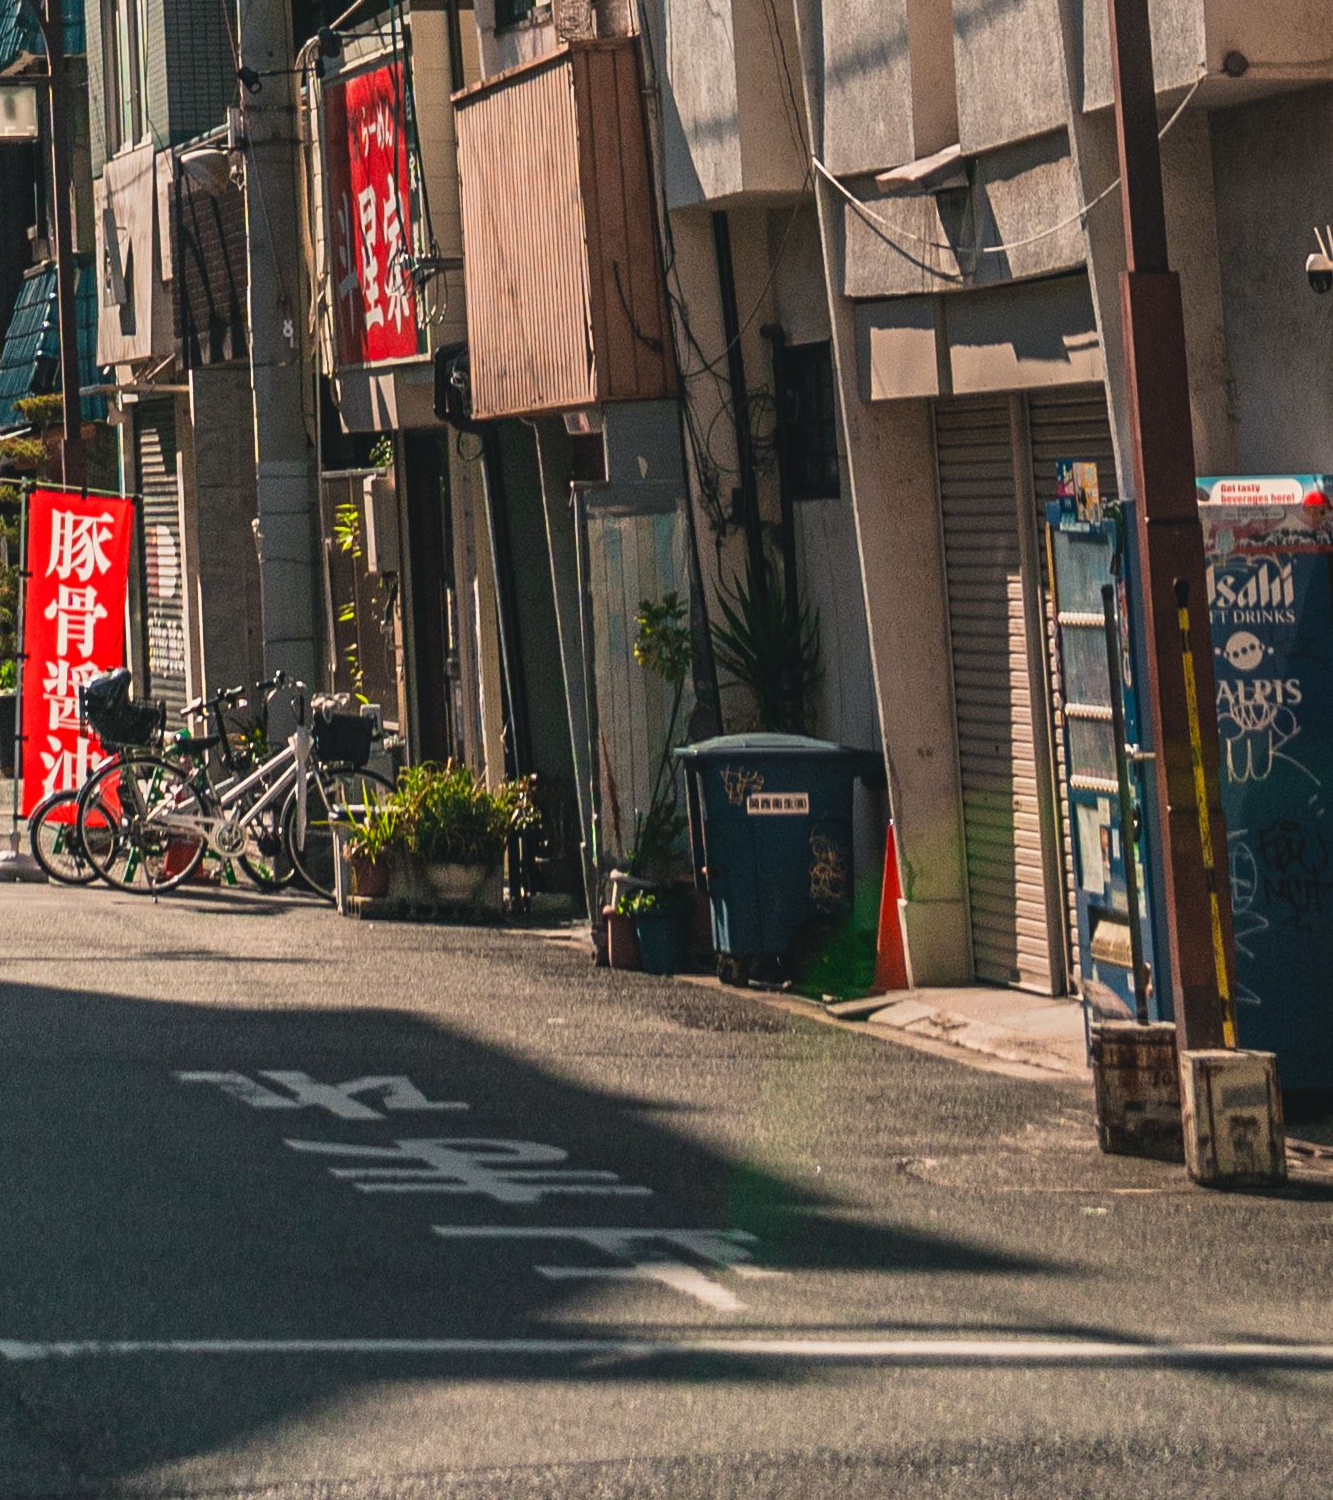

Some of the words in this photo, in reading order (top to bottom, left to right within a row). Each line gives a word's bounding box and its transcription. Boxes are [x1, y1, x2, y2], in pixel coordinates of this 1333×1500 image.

[1220, 484, 1236, 493] Get
[1237, 484, 1261, 494] tasty
[1220, 494, 1269, 505] beverages
[1270, 493, 1295, 505] here!
[1233, 610, 1296, 624] DRINKS
[39, 507, 115, 801] 豚骨醤油
